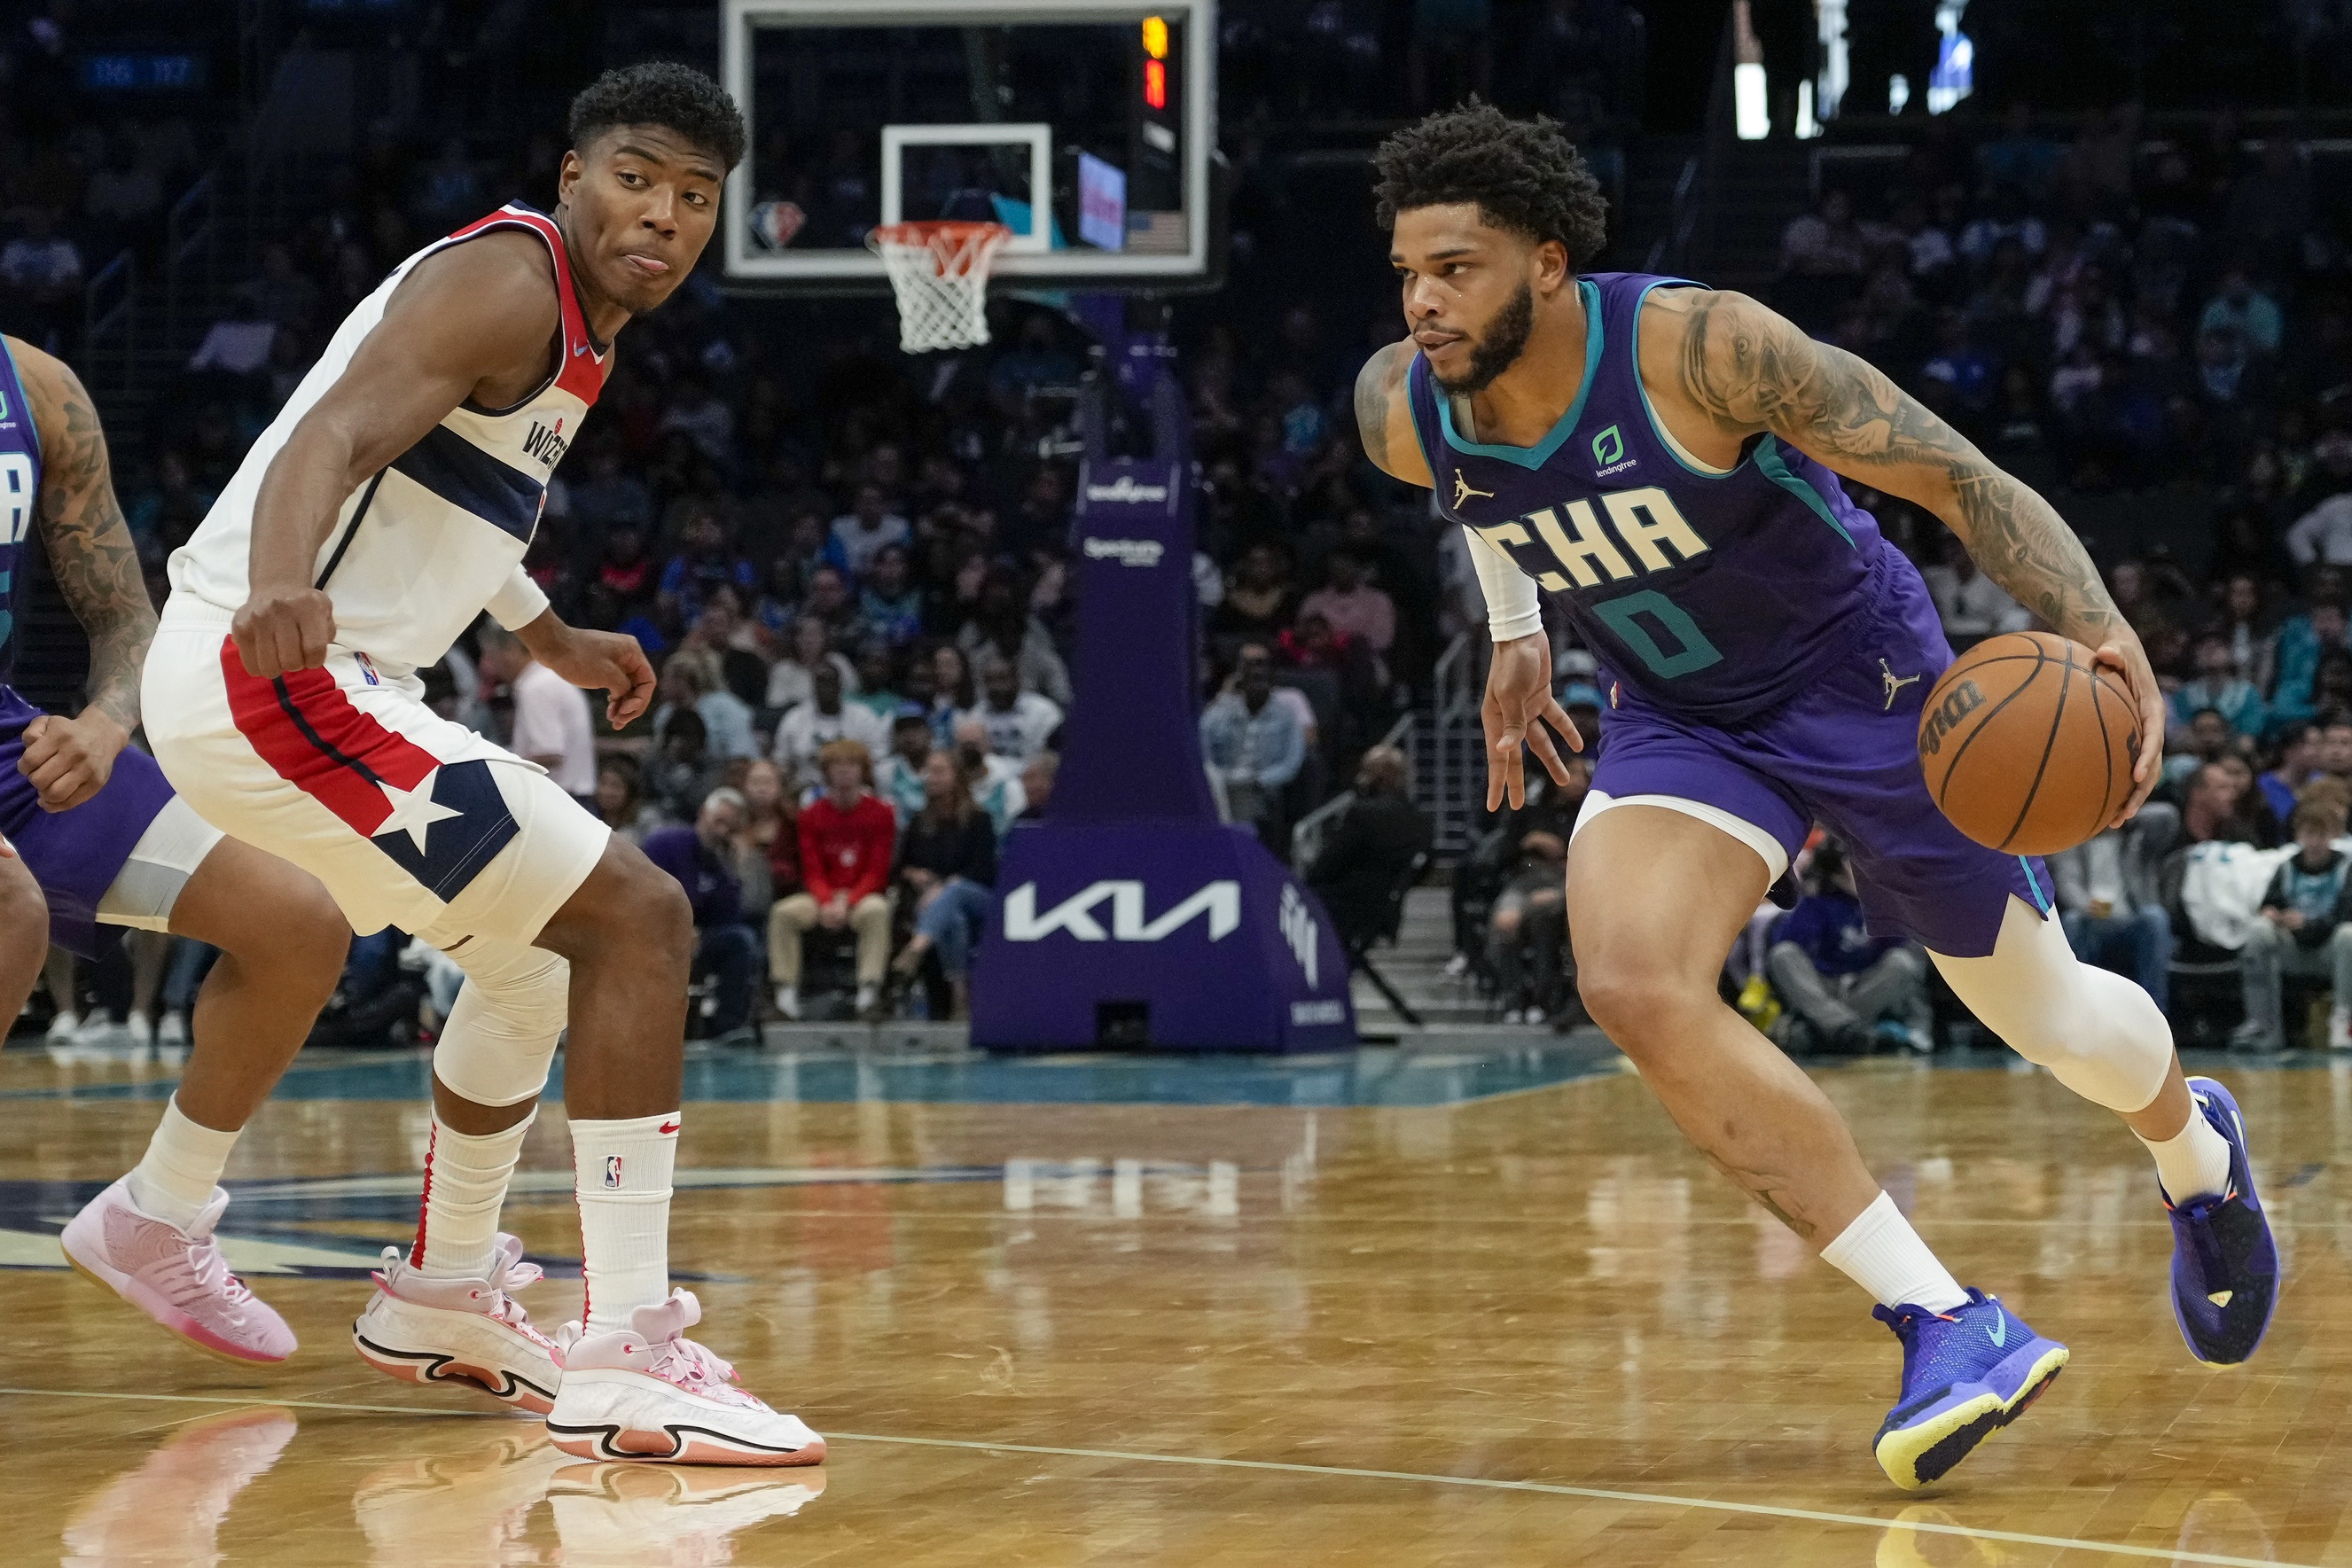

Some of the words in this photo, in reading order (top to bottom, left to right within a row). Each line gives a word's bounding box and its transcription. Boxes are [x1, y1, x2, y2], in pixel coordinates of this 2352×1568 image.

[1596, 459, 1637, 478] lendingtree
[1473, 486, 1712, 592] CHA
[1591, 589, 1724, 679] 0
